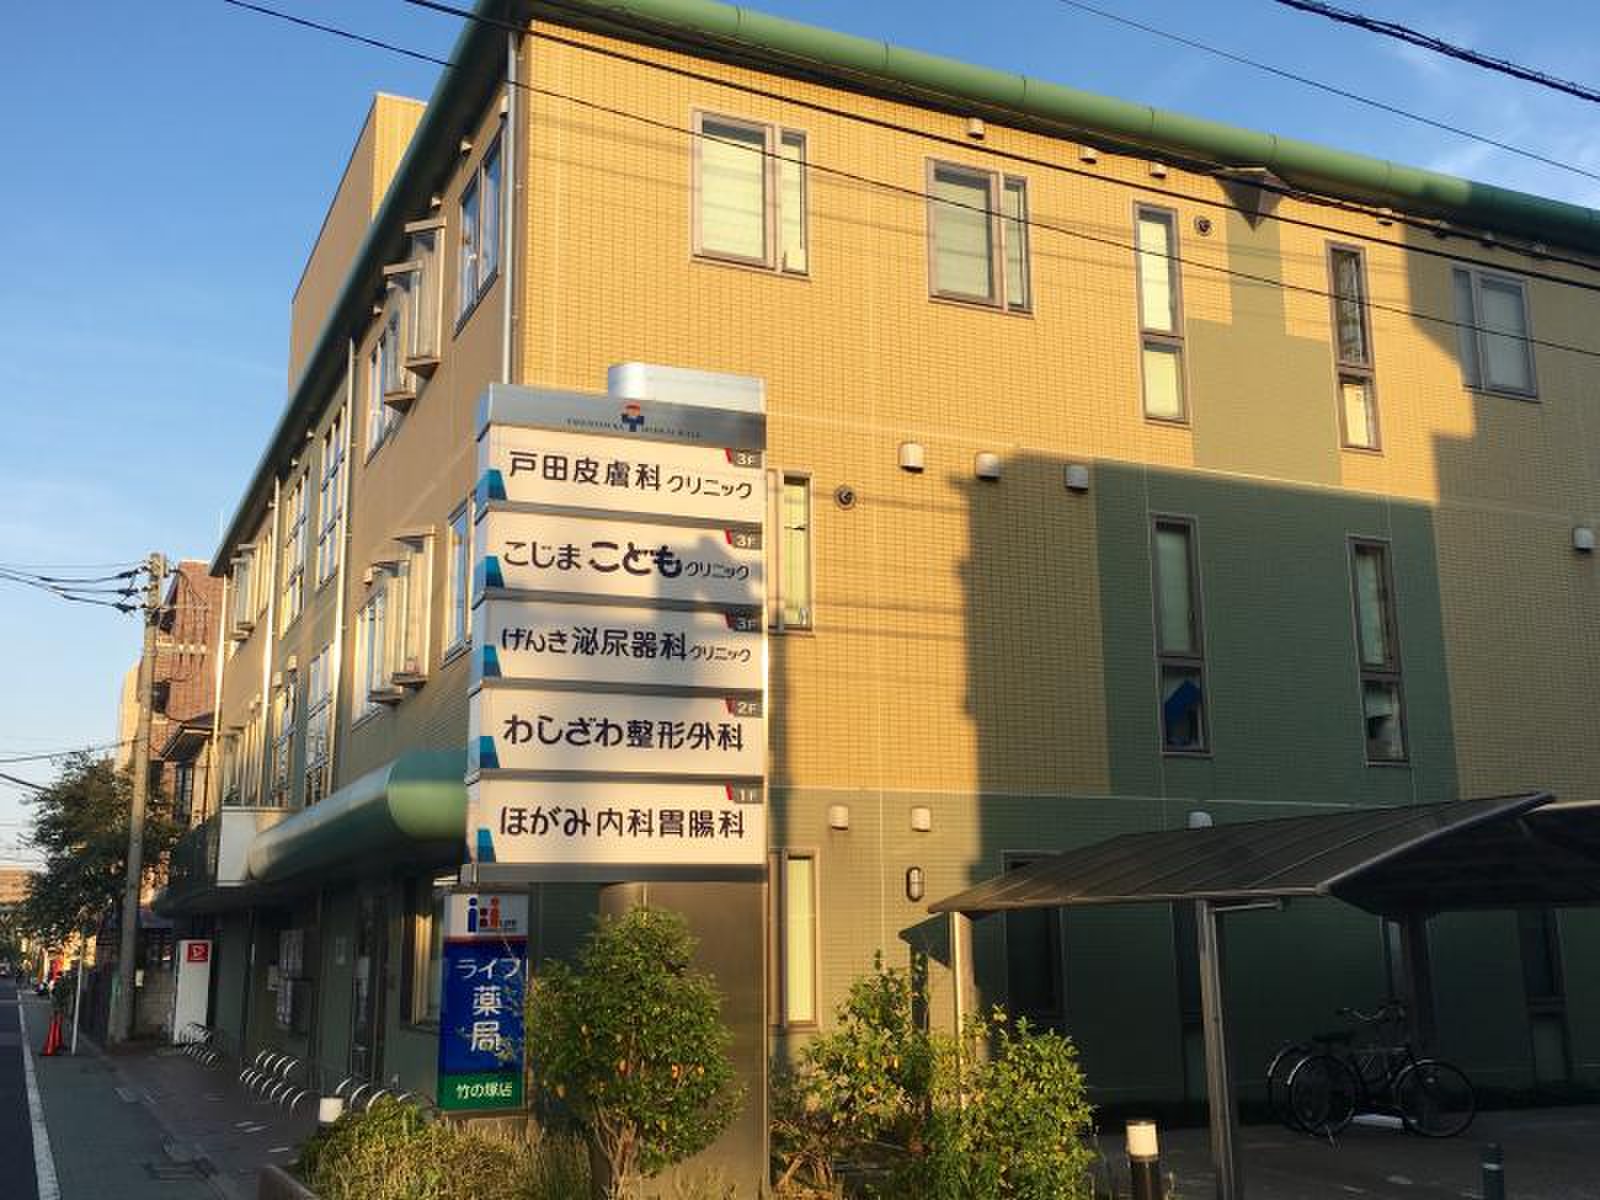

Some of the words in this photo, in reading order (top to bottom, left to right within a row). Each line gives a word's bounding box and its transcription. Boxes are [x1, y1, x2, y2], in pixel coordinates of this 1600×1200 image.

[509, 451, 752, 499] 戸田皮膚科クリニック
[503, 541, 750, 580] こじまこどもクリニック
[502, 627, 752, 663] げんき泌尿器科クリニック
[737, 702, 758, 714] 2F
[503, 714, 744, 752] わしざわ整形外科
[501, 807, 745, 838] ほがみ内科胃腸科
[456, 958, 521, 979] ライフ
[470, 985, 502, 1052] 薬局
